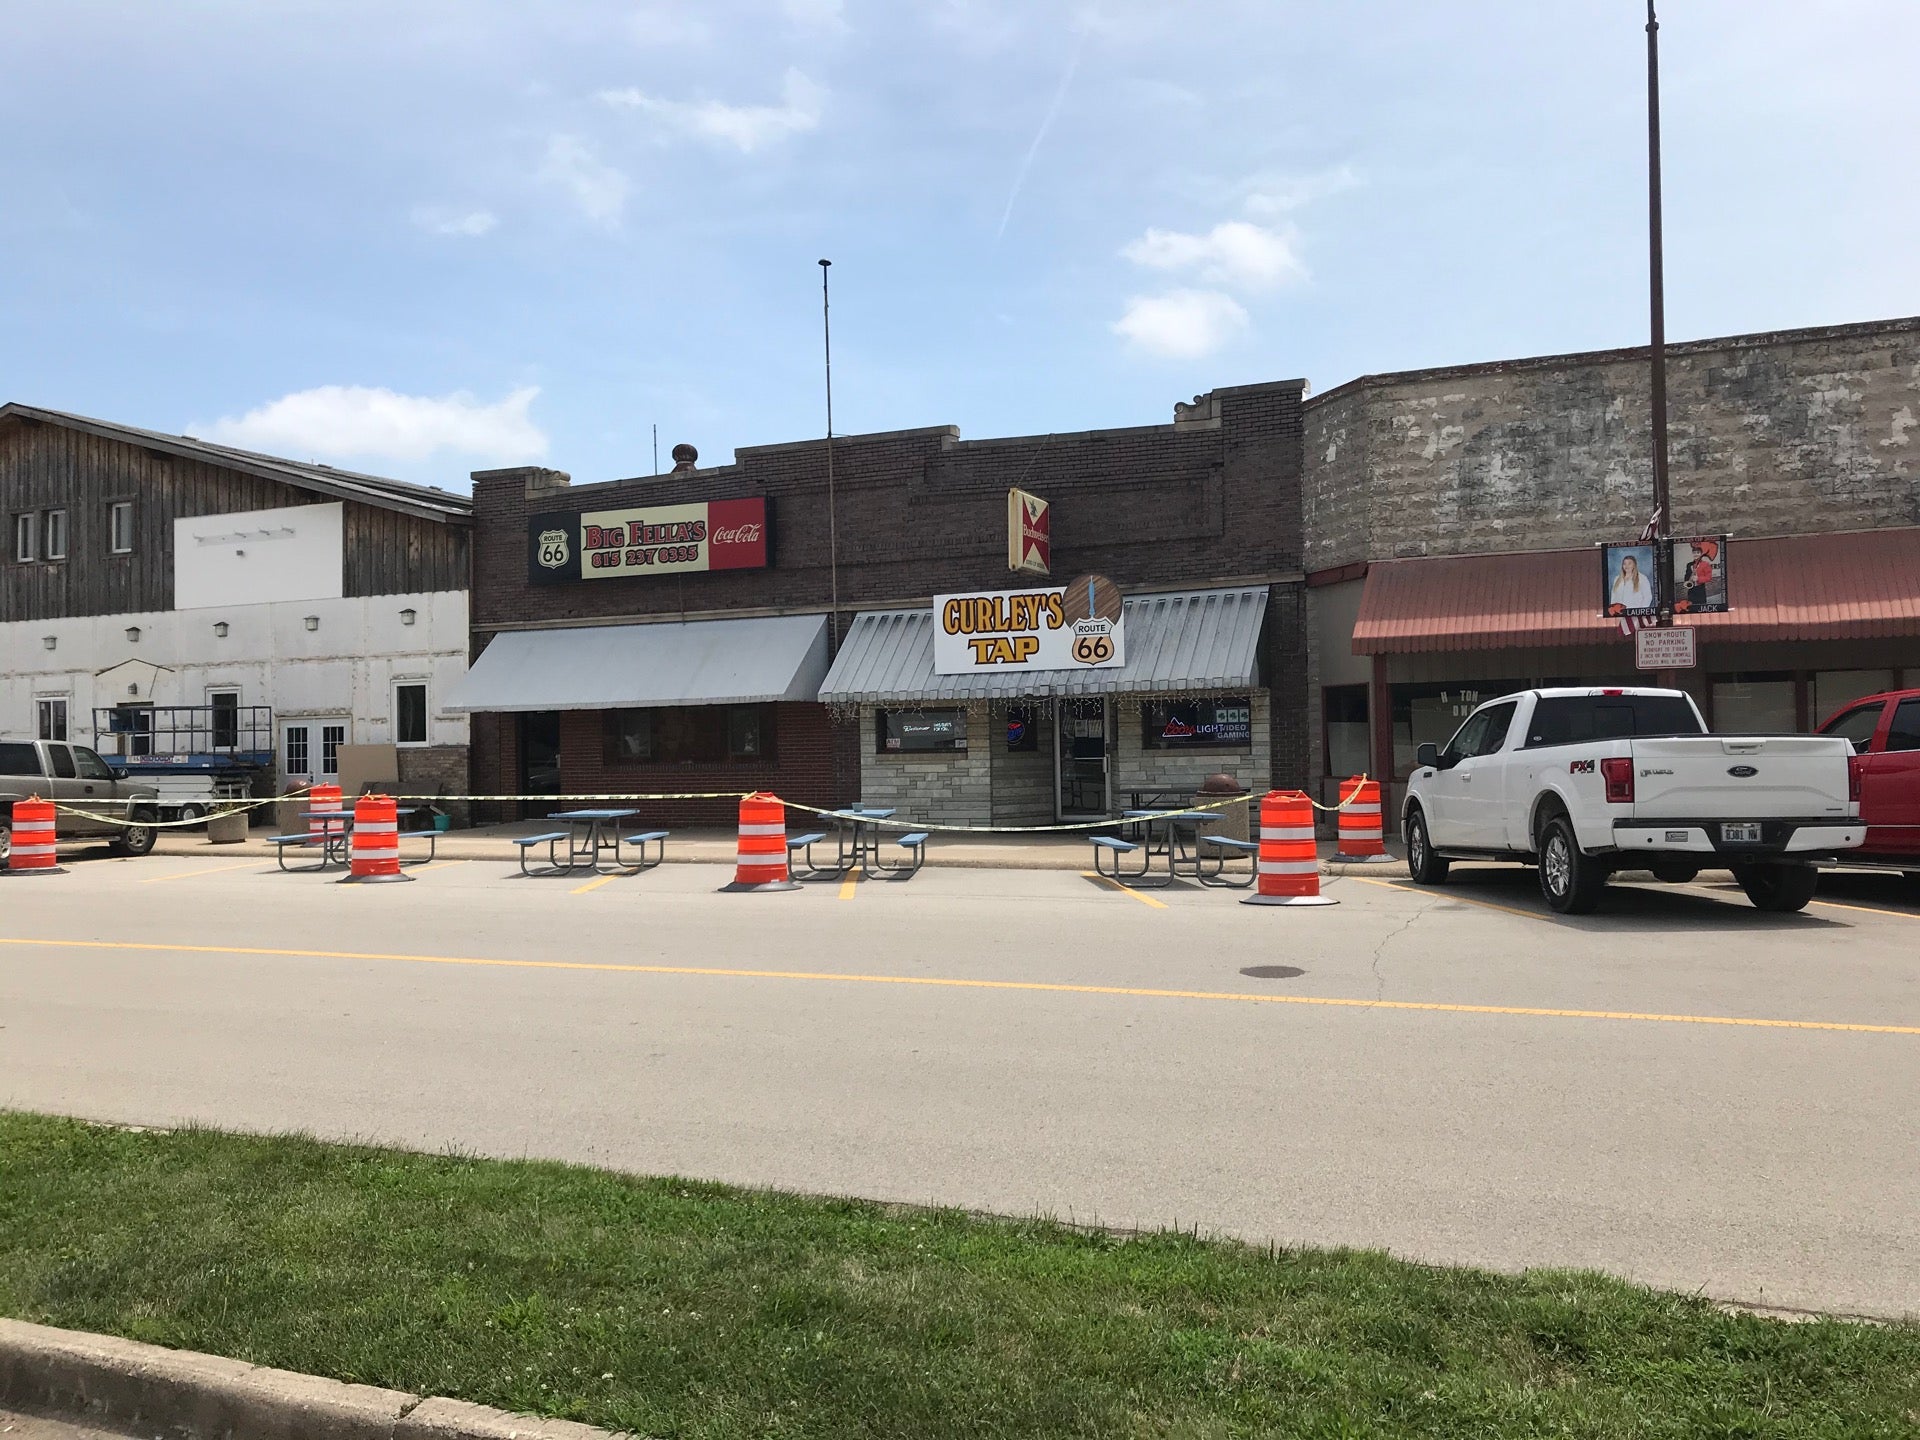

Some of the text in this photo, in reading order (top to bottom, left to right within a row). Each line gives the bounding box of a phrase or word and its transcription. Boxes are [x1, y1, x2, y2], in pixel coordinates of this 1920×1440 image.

[543, 534, 563, 543] ROUTE
[713, 523, 762, 545] Coca-Cola
[1023, 523, 1049, 543] Budweiser
[542, 544, 564, 563] 66
[591, 544, 699, 568] 815 237 8335
[943, 592, 1064, 634] CURLEY'S
[1626, 608, 1656, 616] LAUREN
[1698, 604, 1718, 613] JACK
[1078, 623, 1106, 633] ROUTE
[968, 636, 1039, 665] TAP
[1077, 636, 1108, 659] 66
[1165, 722, 1224, 734] Coors LIGHT
[1570, 760, 1595, 774] FX4
